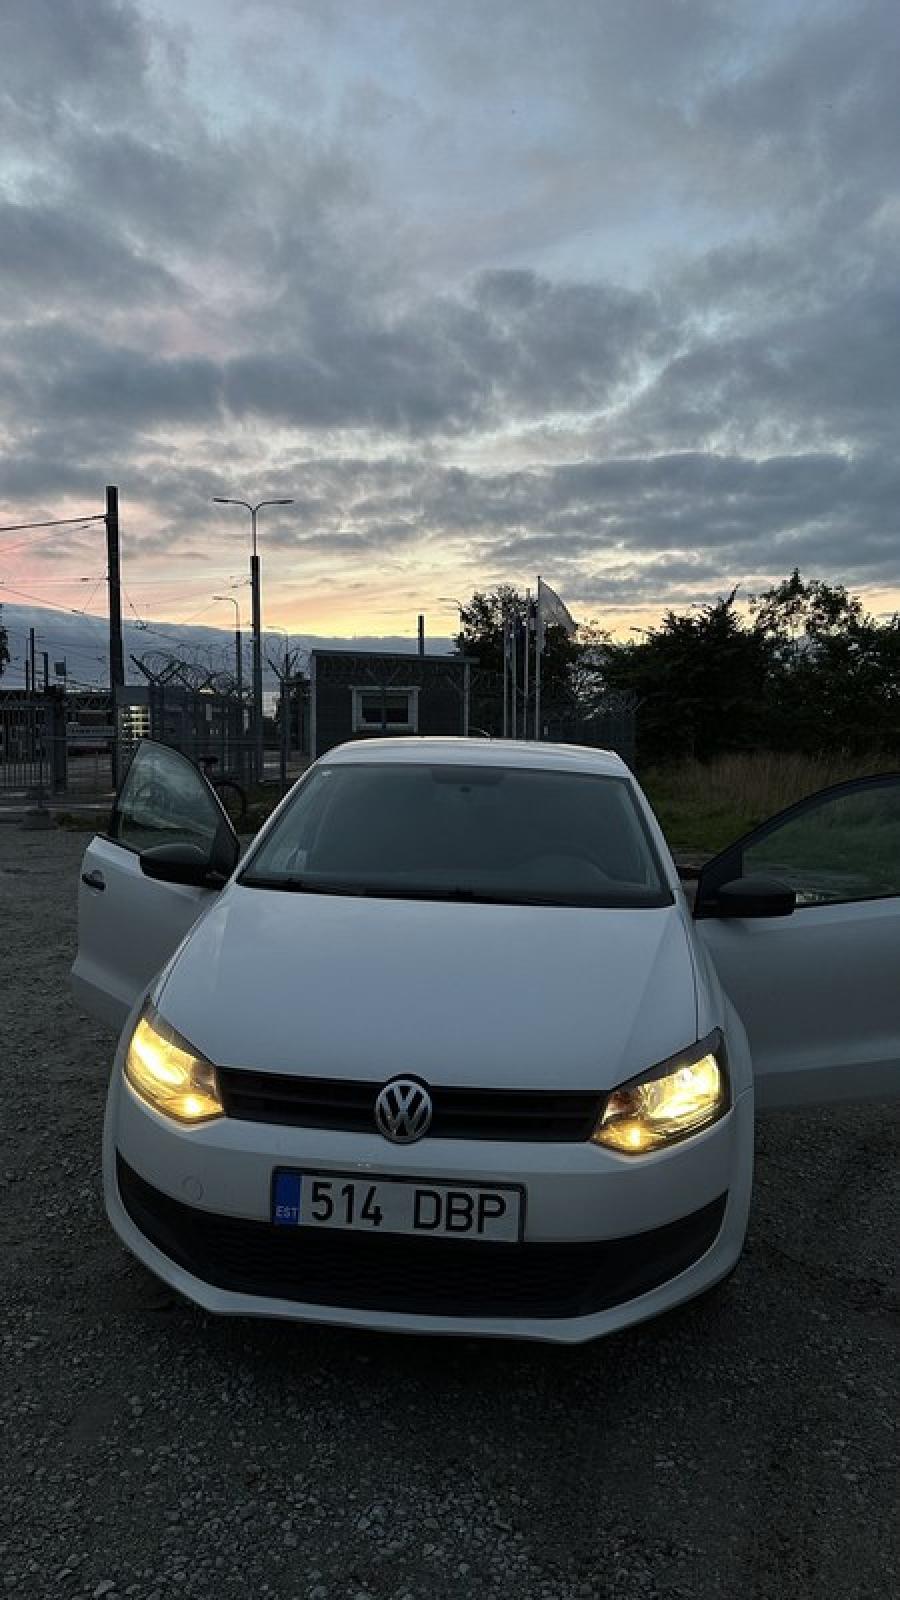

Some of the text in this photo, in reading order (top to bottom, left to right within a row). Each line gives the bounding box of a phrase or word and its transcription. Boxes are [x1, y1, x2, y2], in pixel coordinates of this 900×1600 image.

[375, 1080, 432, 1141] VW
[275, 1206, 299, 1218] EST
[312, 1182, 506, 1233] 514 DBP
